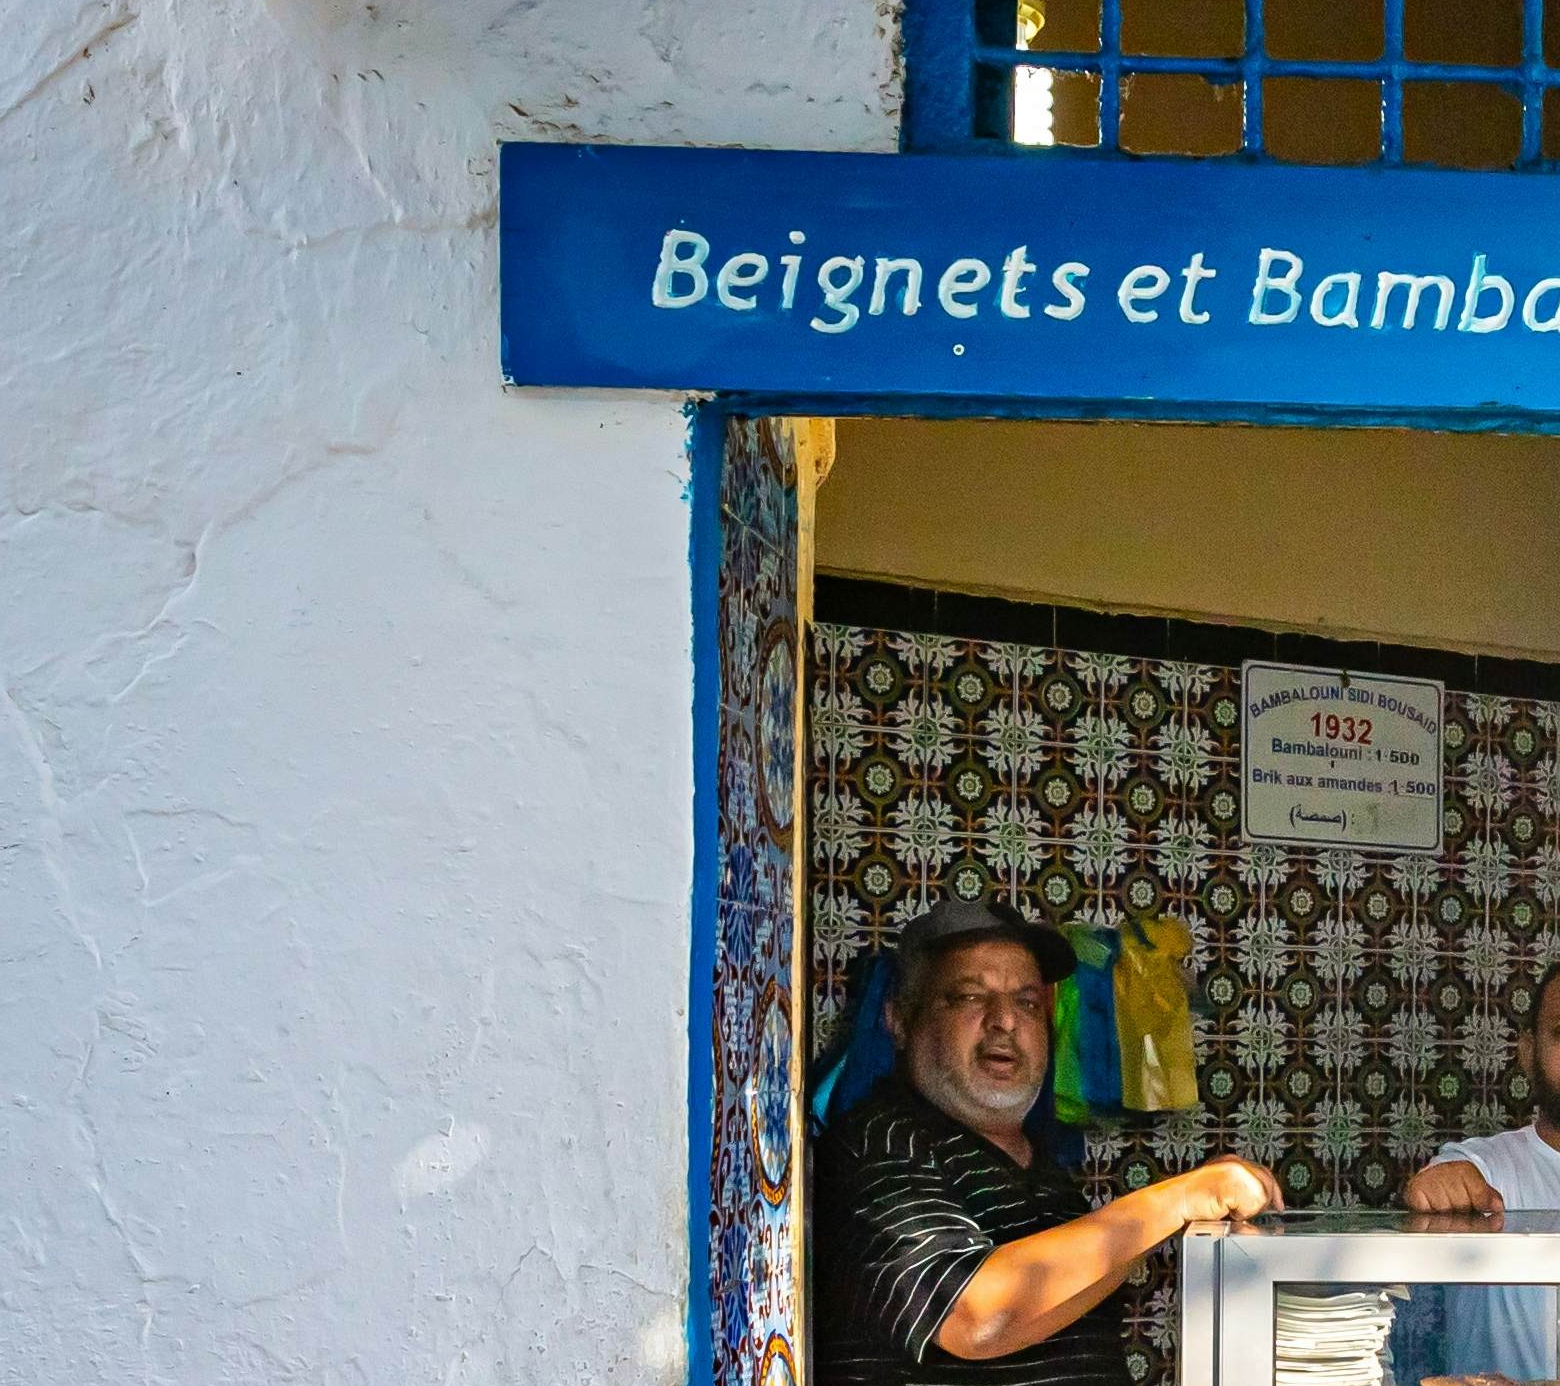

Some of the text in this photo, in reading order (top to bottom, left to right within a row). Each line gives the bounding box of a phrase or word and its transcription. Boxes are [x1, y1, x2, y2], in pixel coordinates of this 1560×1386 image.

[652, 229, 1090, 333] Beignets
[1117, 253, 1216, 324] et
[1249, 685, 1344, 719] BAMBALOUNI
[1348, 690, 1374, 706] SIDI
[1310, 712, 1374, 745] 1932
[1271, 738, 1363, 761] Bambalouni
[1252, 768, 1282, 785] Brik
[1286, 775, 1313, 788] aux
[1317, 774, 1383, 793] amandes
